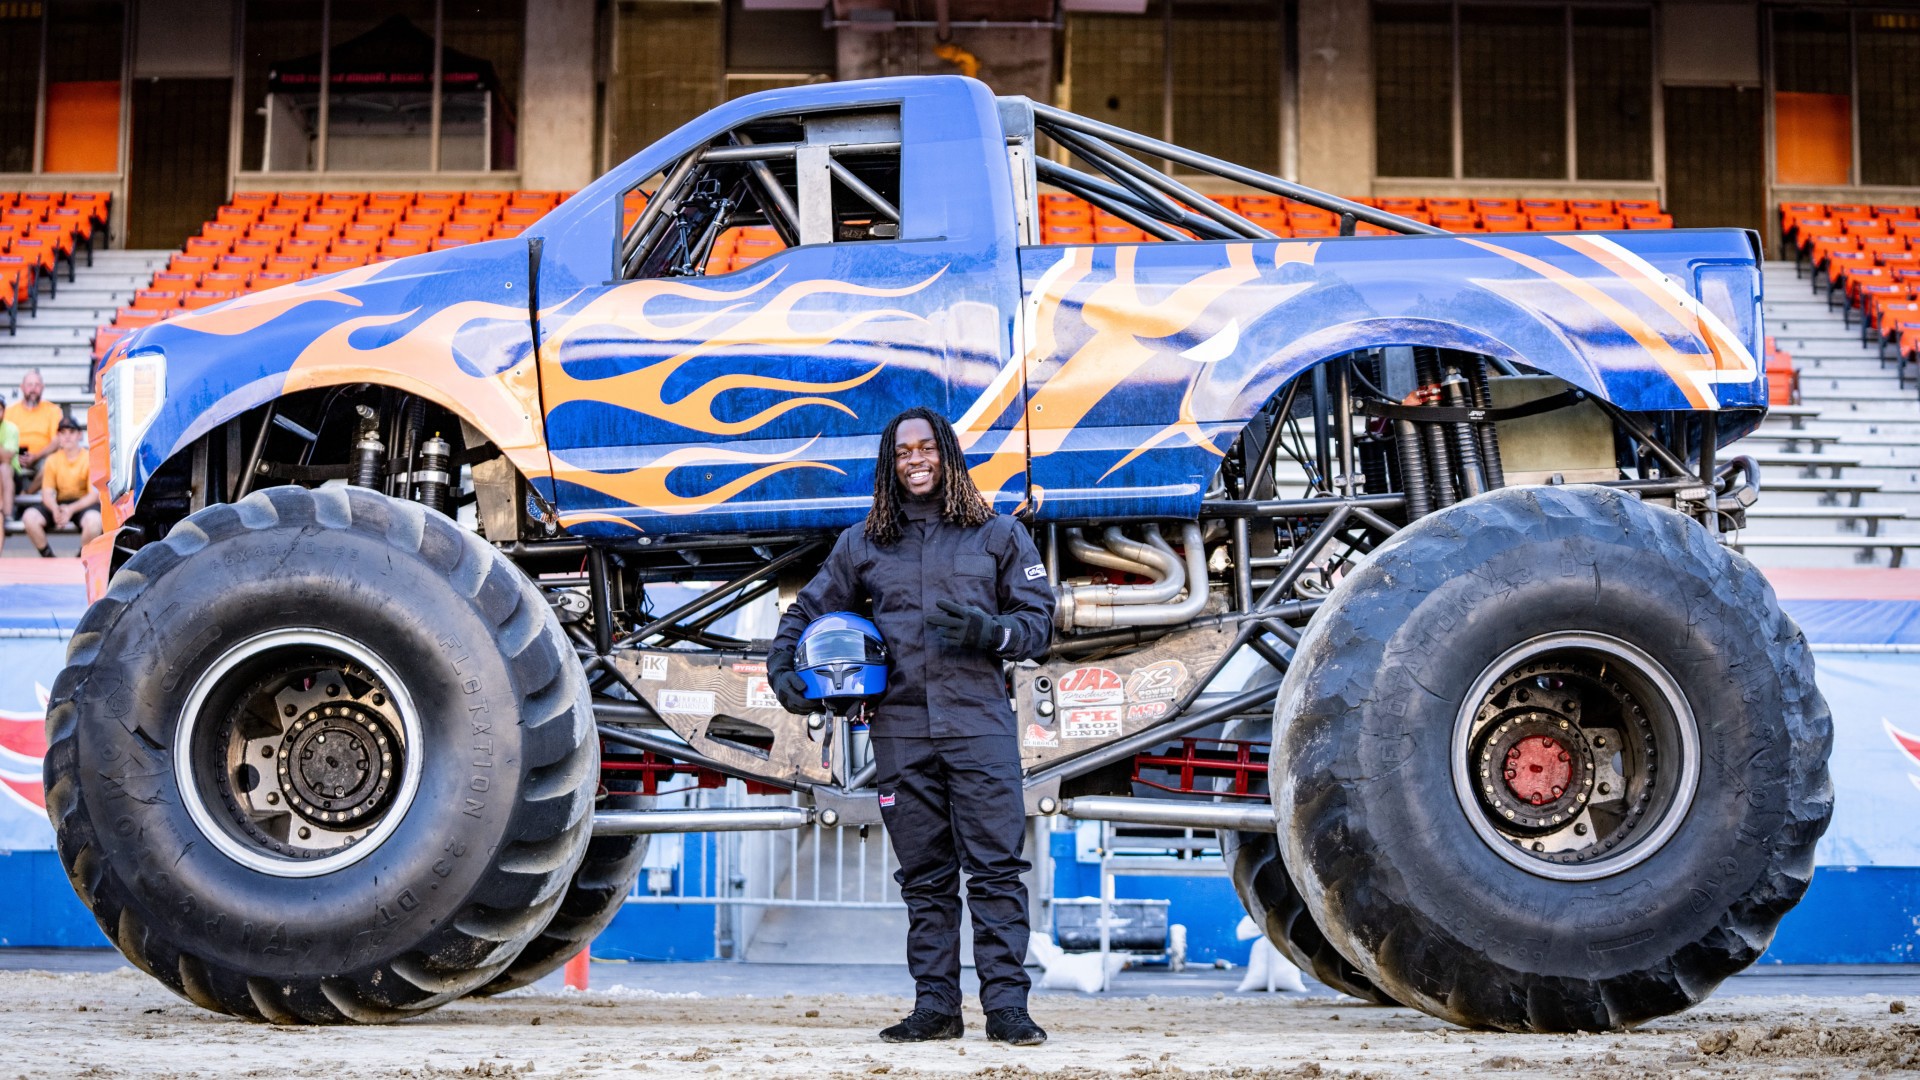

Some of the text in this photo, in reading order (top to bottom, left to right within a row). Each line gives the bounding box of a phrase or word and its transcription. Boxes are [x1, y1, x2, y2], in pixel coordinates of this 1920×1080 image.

[1059, 668, 1121, 691] JAZ
[1135, 667, 1173, 692] XS
[1139, 687, 1174, 696] POWER
[1070, 709, 1118, 722] FK
[1128, 702, 1167, 717] MSD
[434, 630, 495, 822] FLOTATION
[1065, 729, 1118, 737] ENDS
